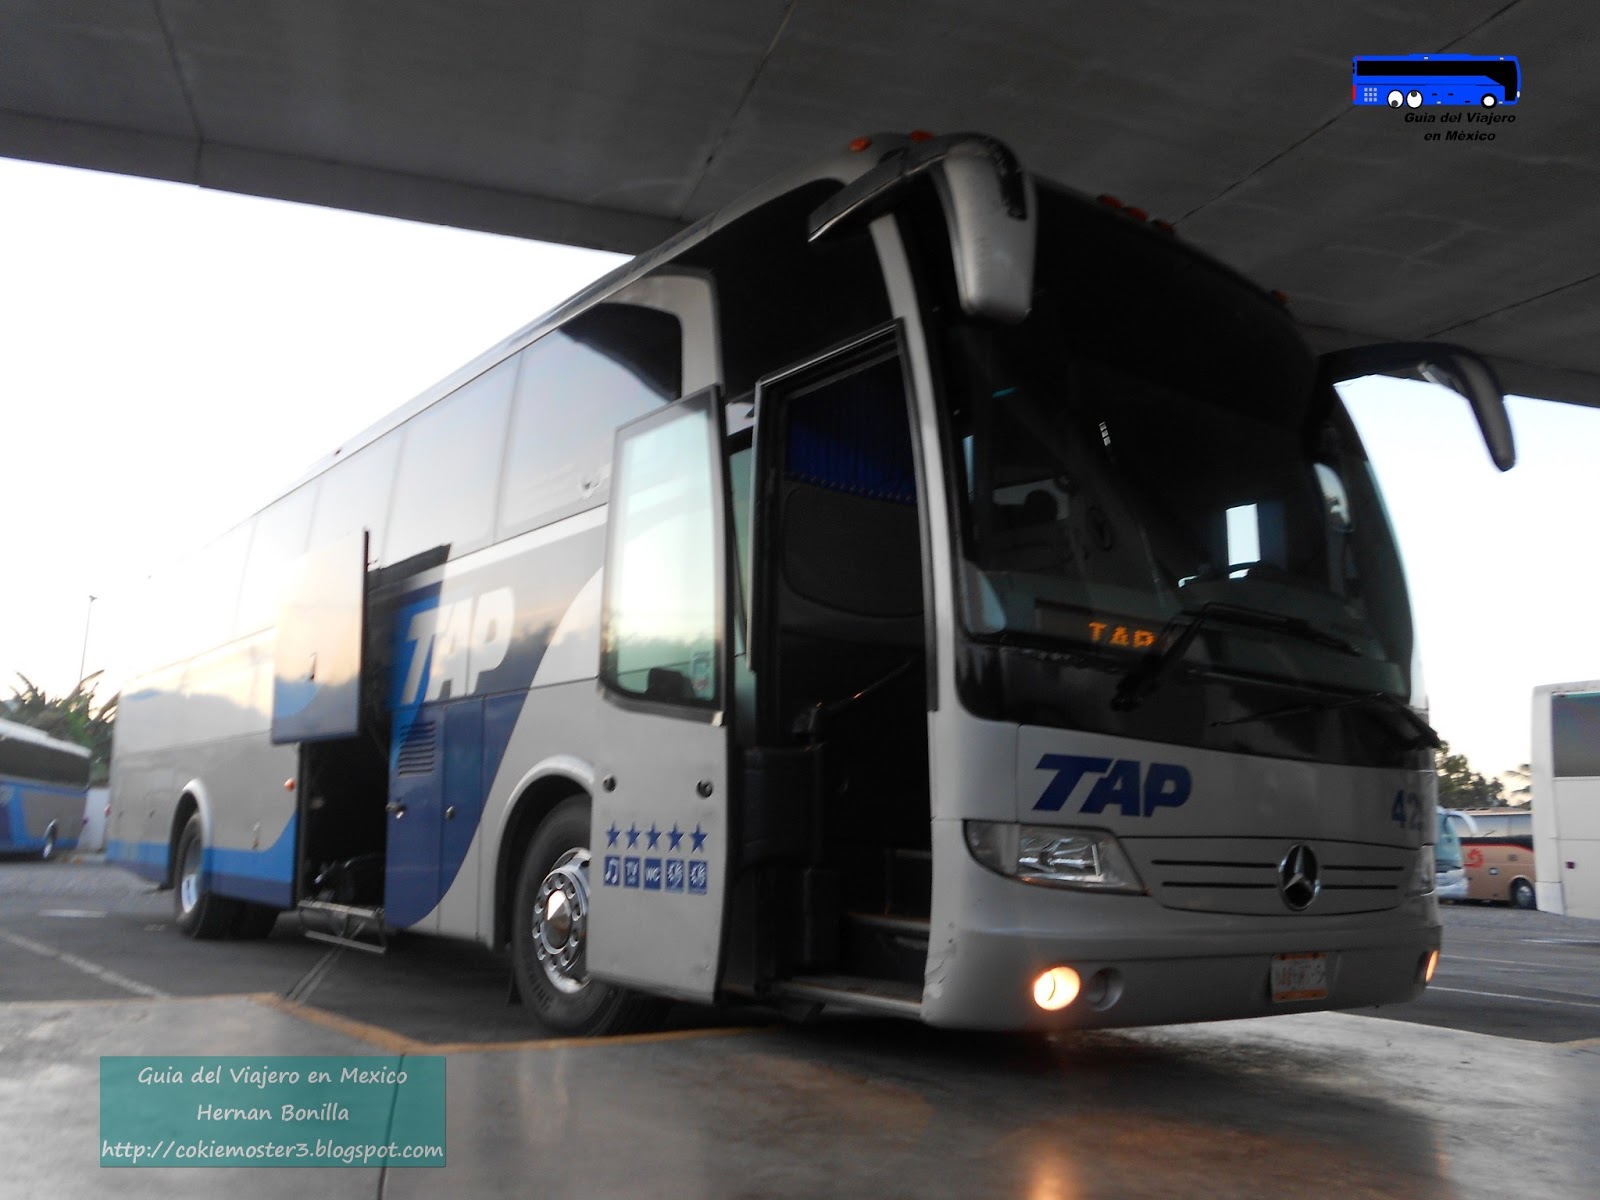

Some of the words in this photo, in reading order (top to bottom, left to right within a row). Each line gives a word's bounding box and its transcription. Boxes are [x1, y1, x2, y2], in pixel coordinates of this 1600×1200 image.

[402, 586, 514, 705] TAP
[1032, 753, 1192, 818] TAP
[645, 866, 660, 882] WC
